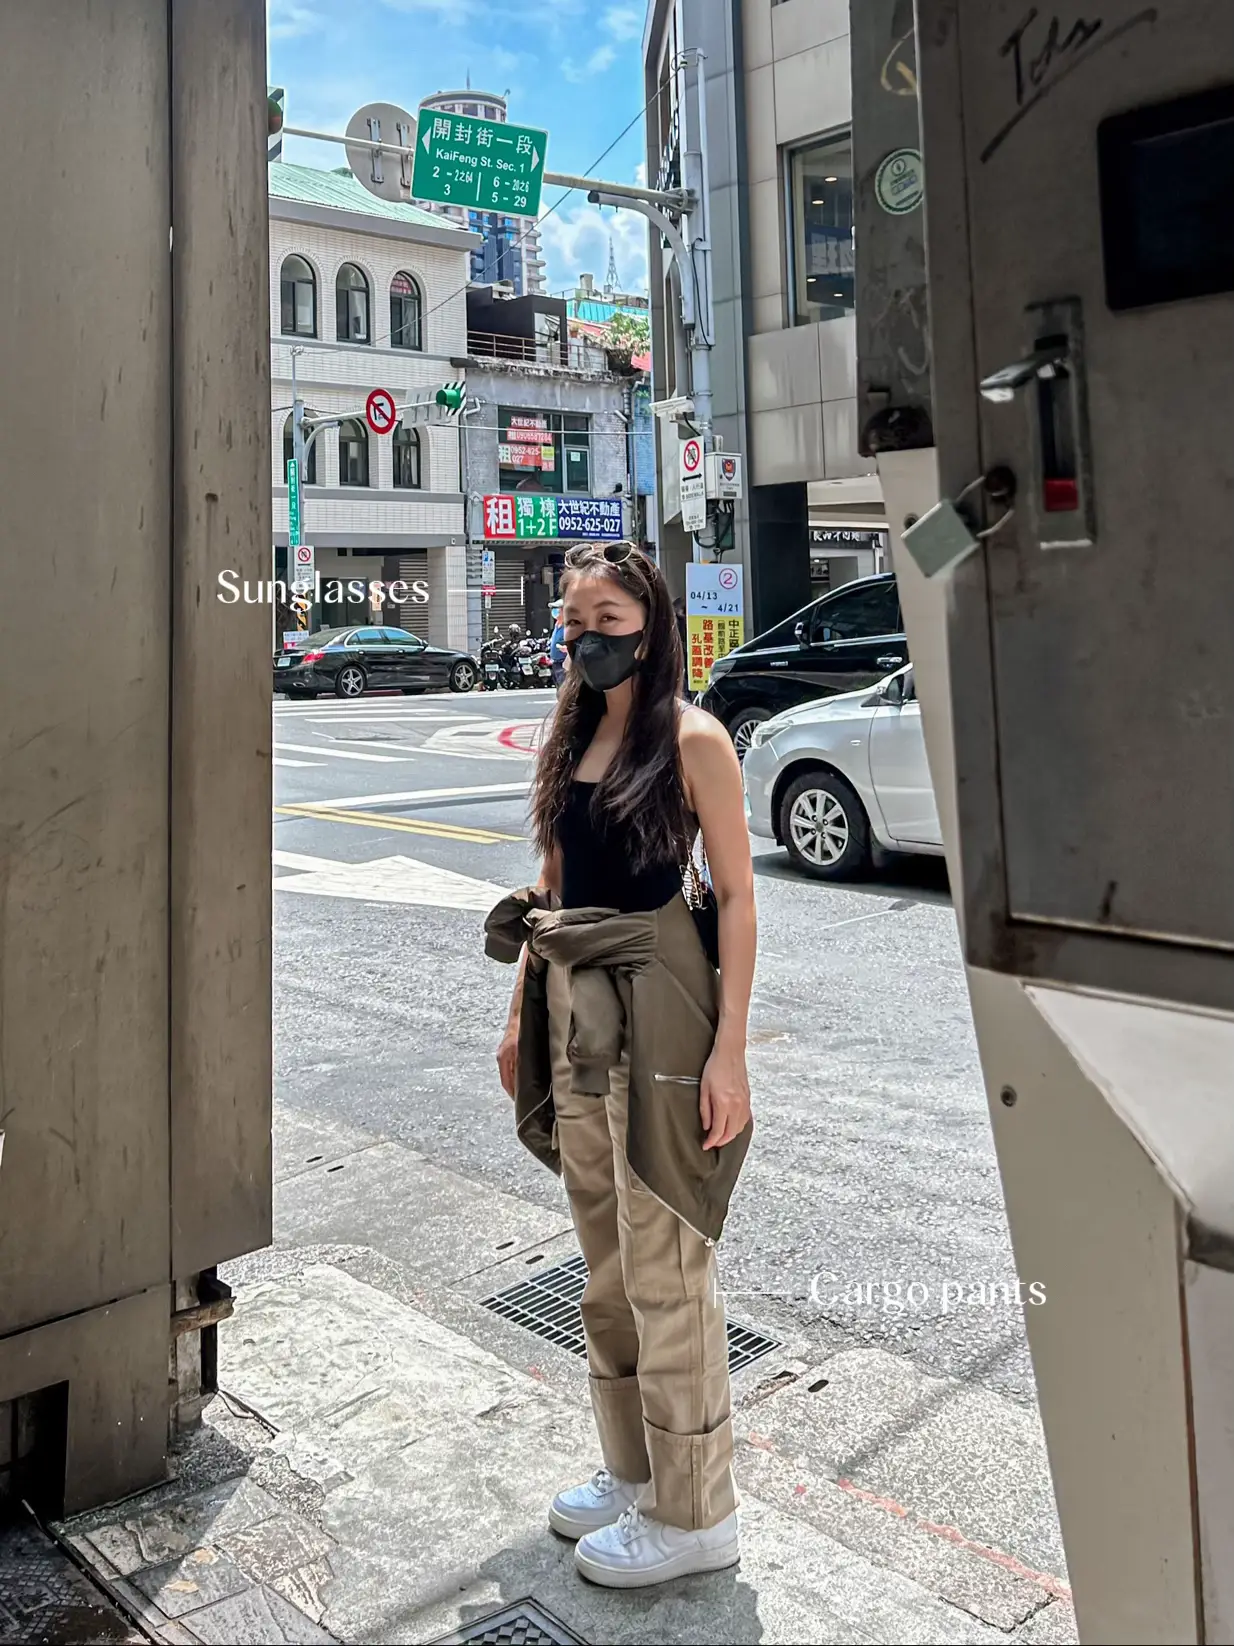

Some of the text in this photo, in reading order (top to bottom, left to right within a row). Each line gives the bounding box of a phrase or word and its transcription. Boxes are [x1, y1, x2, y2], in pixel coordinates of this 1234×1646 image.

[432, 118, 532, 155] 開封街一段
[435, 148, 525, 173] KaiFeng St. Sec. 1
[432, 166, 440, 178] 2
[444, 183, 451, 195] 3
[493, 176, 500, 188] 6
[491, 192, 499, 203] 5
[513, 195, 527, 208] 29
[499, 445, 511, 463] 租
[486, 497, 516, 535] 租
[558, 499, 620, 517] 大世紀不動產
[558, 516, 621, 532] 0952-625-027
[690, 591, 718, 601] 04/13
[717, 602, 739, 613] 4/21
